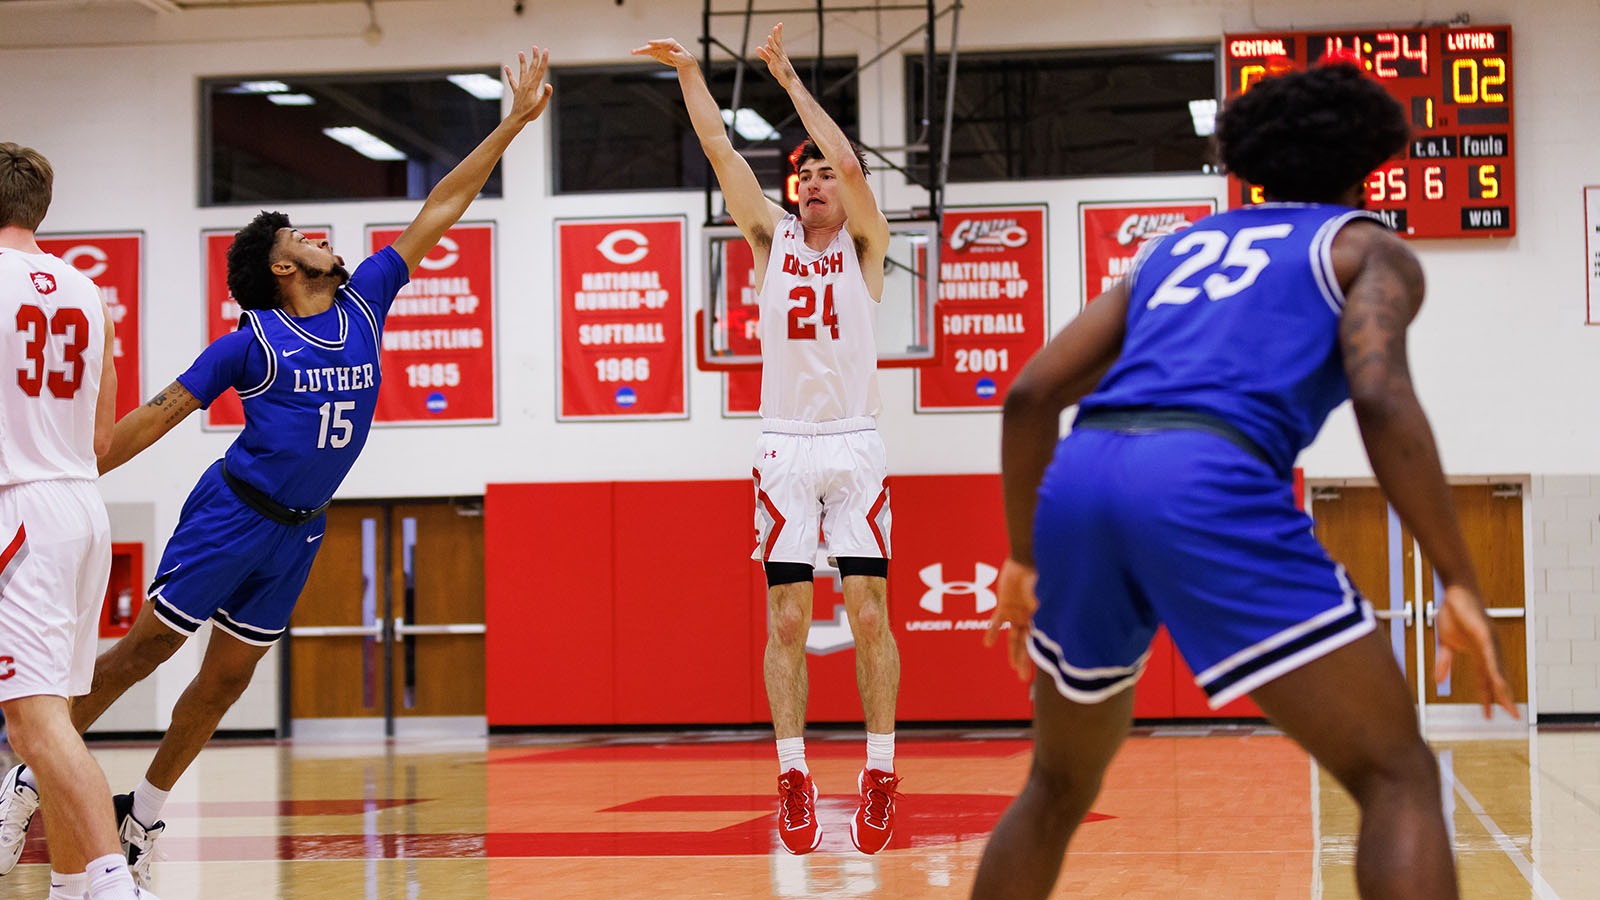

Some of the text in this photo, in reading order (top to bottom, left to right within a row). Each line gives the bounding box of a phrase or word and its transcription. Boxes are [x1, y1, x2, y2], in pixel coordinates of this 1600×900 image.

[1230, 39, 1287, 57] CENTRAL
[1447, 32, 1495, 51] LUTHER
[1452, 57, 1506, 104] 02
[1463, 135, 1503, 156] fouls
[1424, 166, 1444, 200] 6
[1478, 164, 1499, 199] 5
[1469, 210, 1502, 227] won
[782, 250, 844, 276] DUTCH
[941, 261, 1021, 280] NATIONAL
[1146, 223, 1293, 310] 25
[400, 277, 470, 296] ATIONAL
[582, 272, 661, 291] NATIONAL
[575, 290, 669, 311] RUNNER-UP
[787, 283, 840, 340] 24
[579, 323, 665, 346] SOFTBALL
[943, 314, 1026, 336] SOFTBALL
[383, 328, 483, 351] WRESTLING
[15, 304, 89, 399] 33
[955, 349, 1009, 373] 2001
[293, 363, 374, 392] LUTHER
[406, 363, 461, 388] 1985
[595, 357, 650, 382] 1986
[317, 400, 356, 449] 15
[905, 620, 1012, 631] UNDER ARMOR
